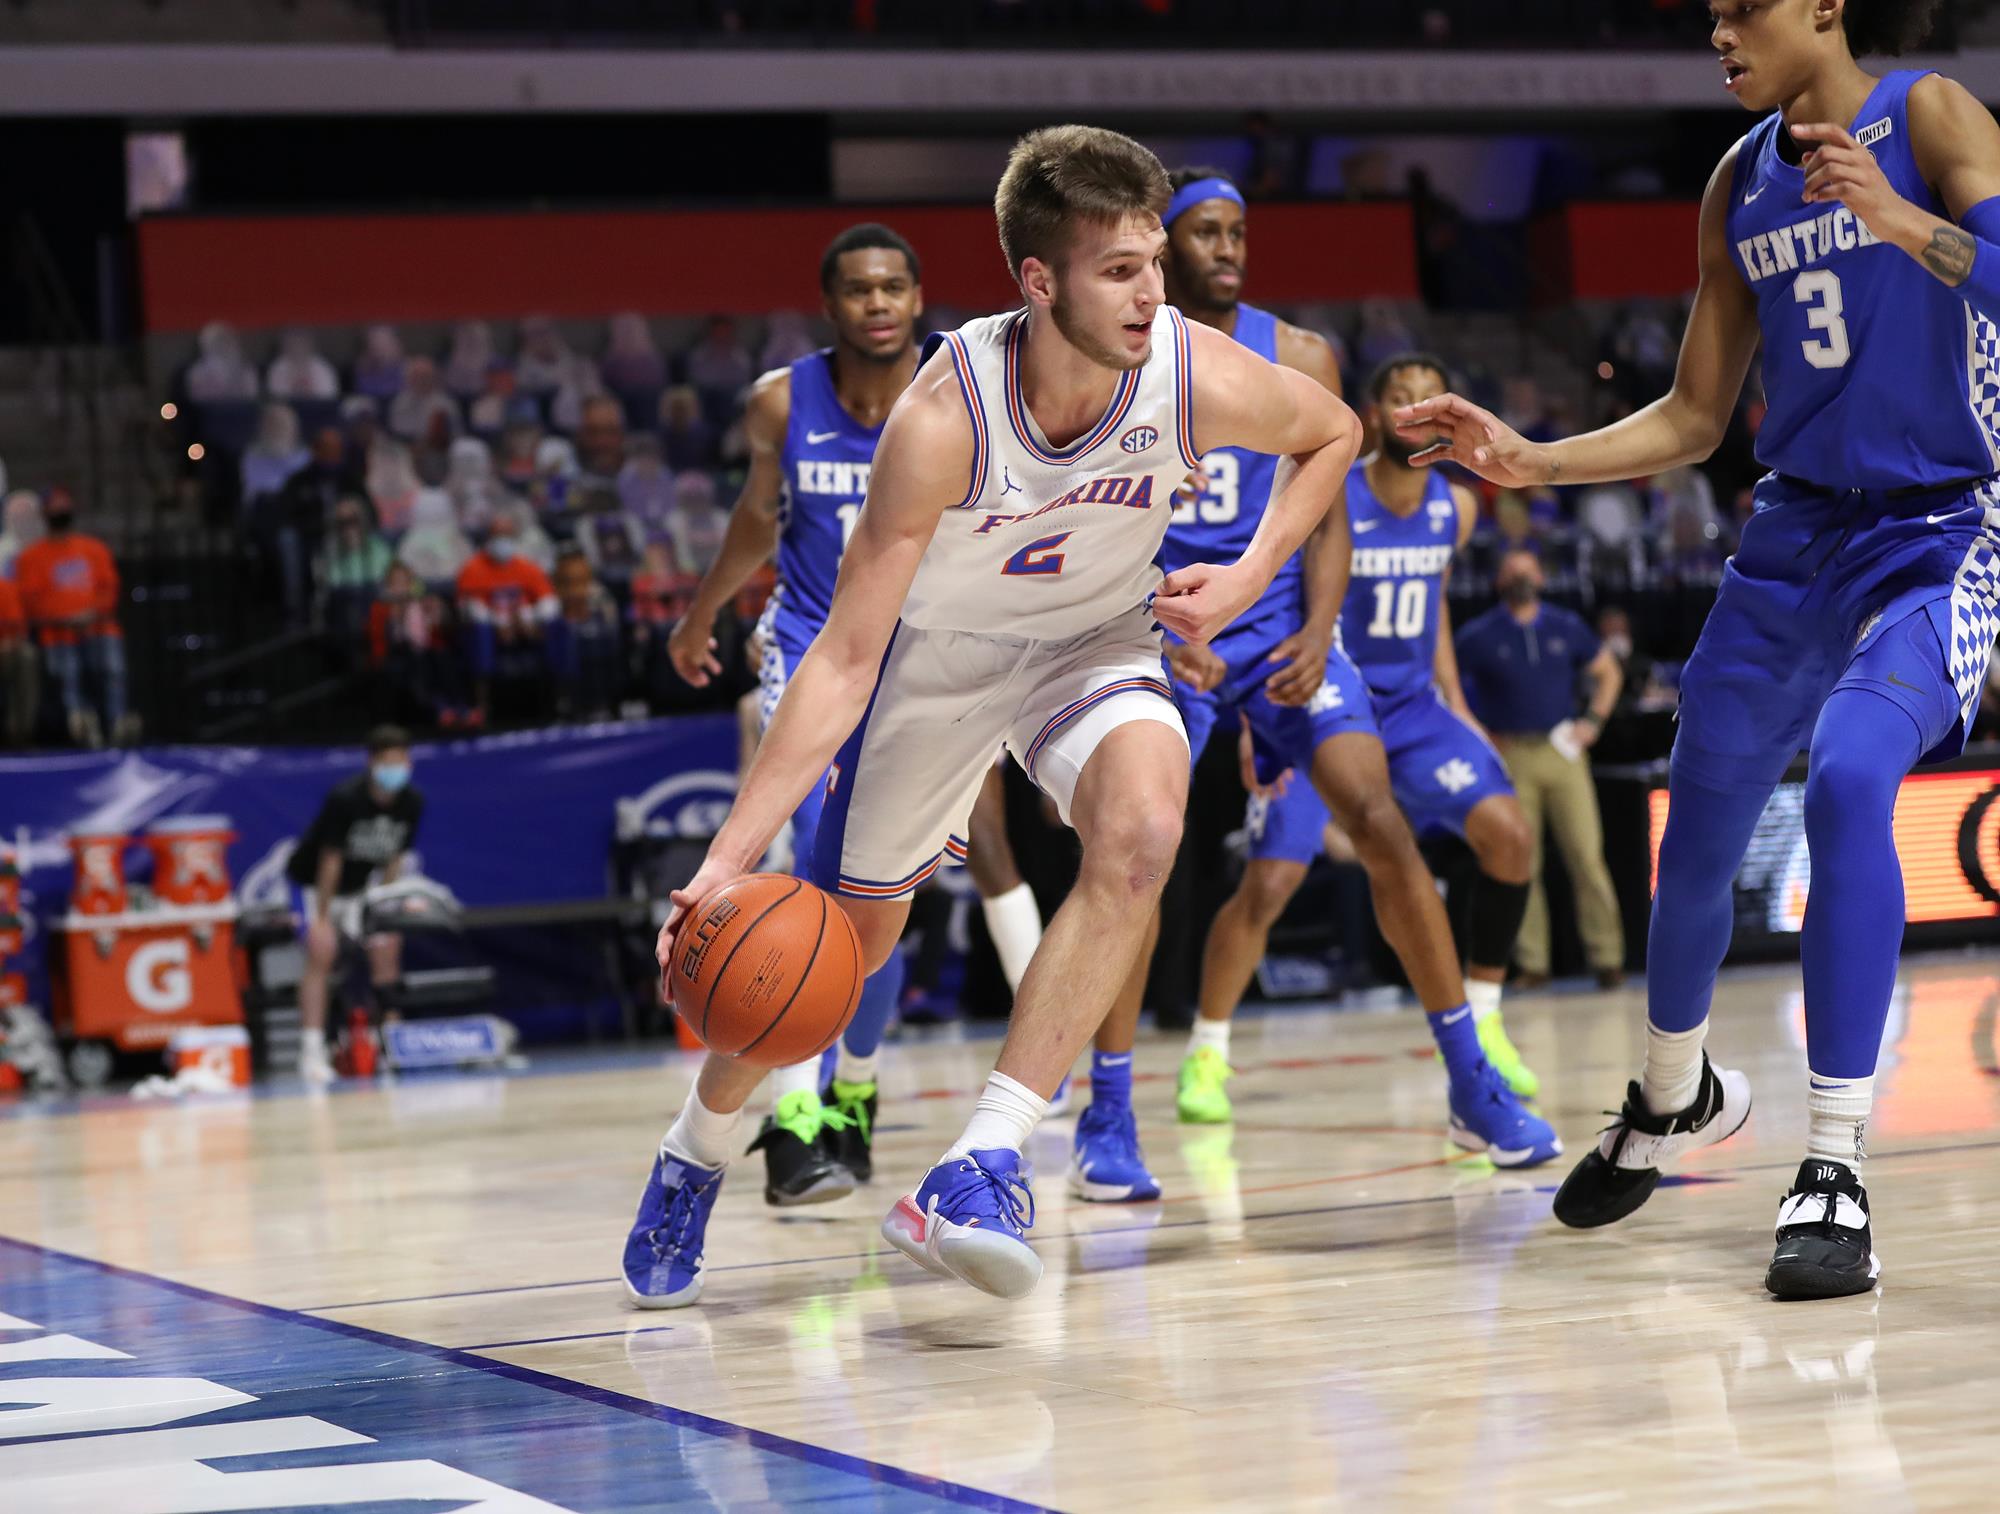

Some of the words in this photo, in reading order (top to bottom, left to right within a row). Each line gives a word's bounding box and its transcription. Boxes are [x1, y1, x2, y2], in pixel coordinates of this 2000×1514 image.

[1736, 207, 1886, 282] KENTUC
[1793, 269, 1851, 369] 3
[1122, 428, 1157, 452] SEC
[796, 460, 872, 496] KENT
[1000, 530, 1078, 576] 2
[1367, 578, 1428, 639] 10
[126, 938, 193, 1014] G
